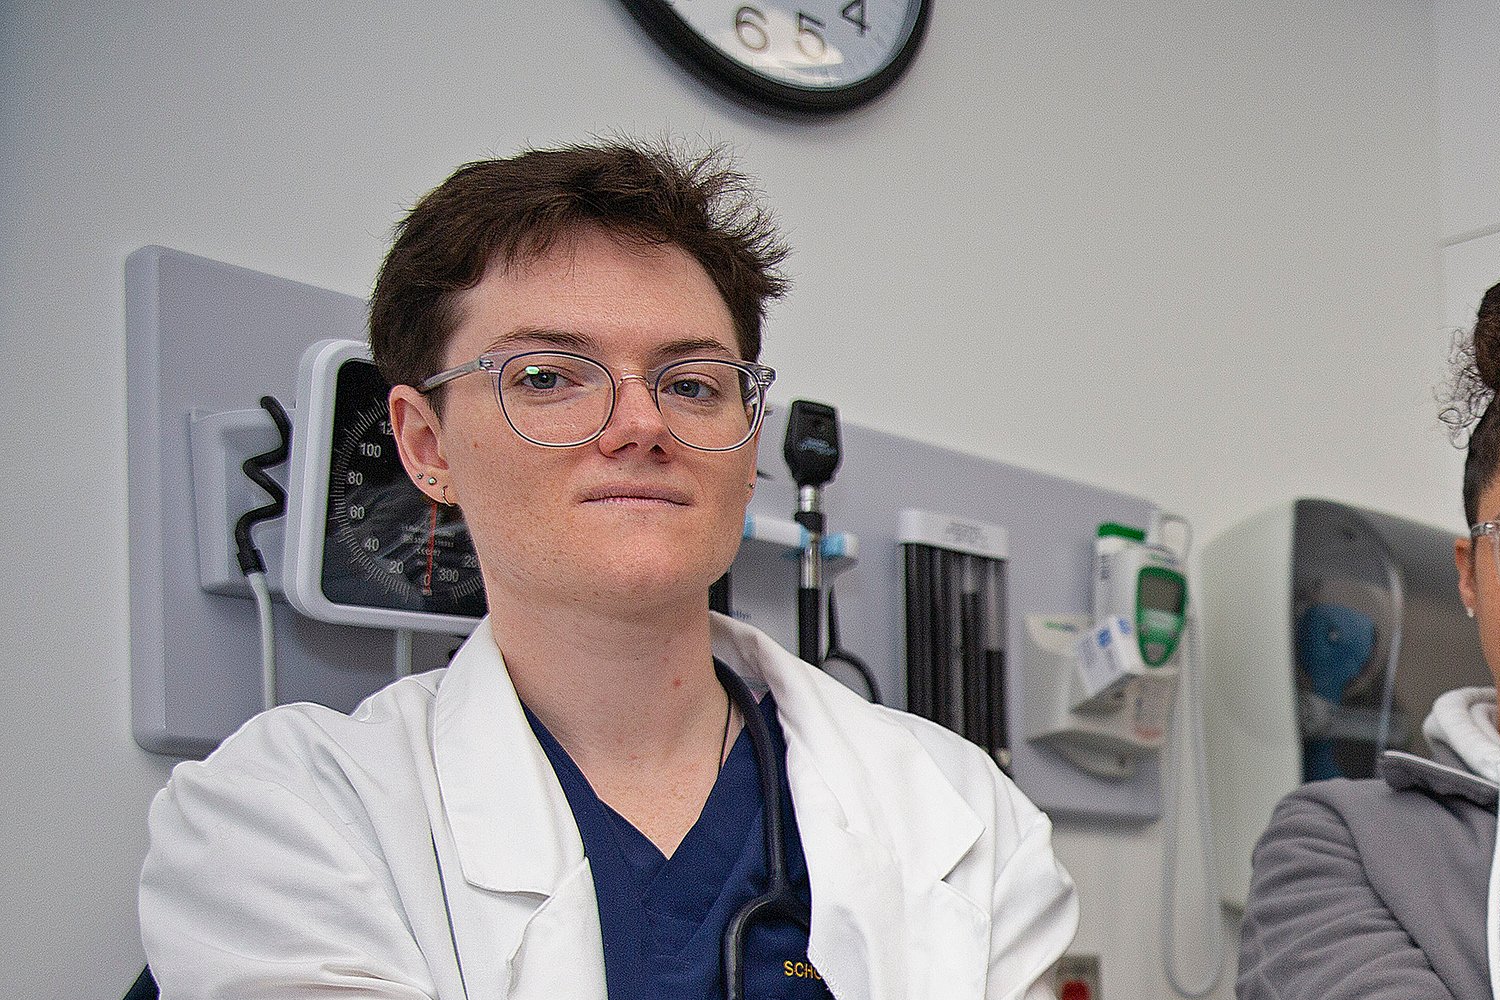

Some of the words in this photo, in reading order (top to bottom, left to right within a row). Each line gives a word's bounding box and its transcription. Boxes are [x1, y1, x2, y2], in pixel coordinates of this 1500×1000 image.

[842, 0, 870, 37] 4
[736, 6, 769, 53] 6
[798, 12, 826, 58] 5
[380, 421, 395, 436] 12
[360, 443, 382, 459] 100
[348, 471, 364, 486] 80
[350, 505, 365, 520] 60
[364, 537, 380, 552] 40
[389, 560, 404, 575] 20
[439, 568, 459, 583] 300
